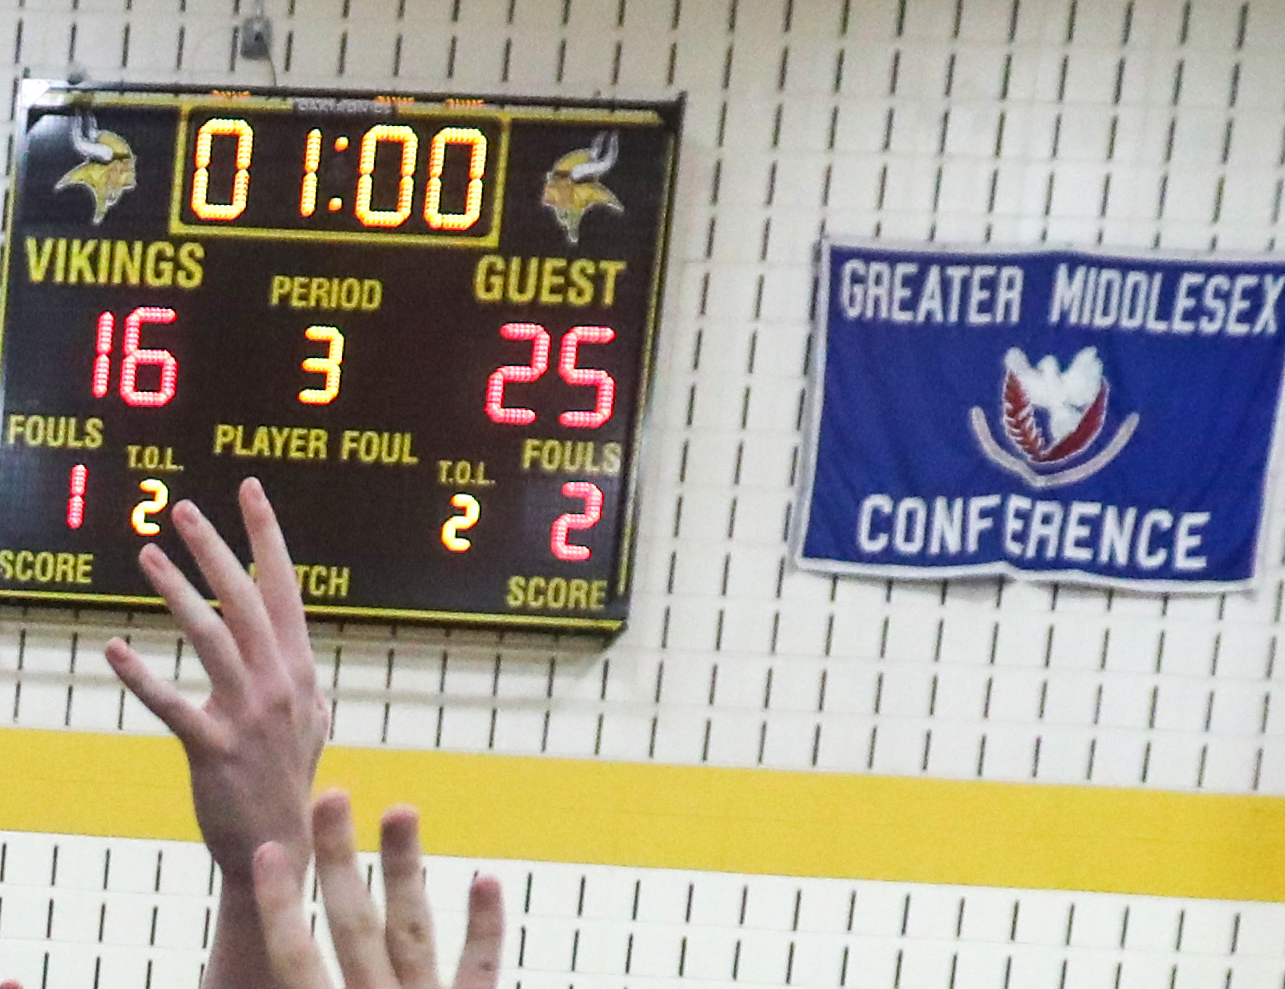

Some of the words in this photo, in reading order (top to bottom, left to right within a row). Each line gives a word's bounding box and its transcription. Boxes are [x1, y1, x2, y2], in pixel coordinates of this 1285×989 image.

[25, 237, 205, 290] VIKINGS
[473, 254, 627, 306] GUEST
[269, 274, 383, 312] PERIOD
[841, 258, 1024, 326] GREATER
[1049, 262, 1285, 338] MIDDLESEX
[91, 306, 177, 406] 16
[298, 325, 345, 404] 3
[484, 322, 616, 428] 25
[7, 413, 104, 449] FOULS
[126, 445, 184, 472] T.O.L.
[213, 424, 327, 461] PLAYER
[340, 429, 418, 465] FOUL
[521, 438, 622, 476] FOULS
[66, 463, 88, 528] 1
[437, 461, 495, 487] T.O.L.
[131, 478, 168, 536] 2
[441, 492, 480, 552] 2
[550, 480, 603, 561] 2
[856, 493, 1211, 571] CONFERENCE
[507, 573, 608, 610] SCORE
